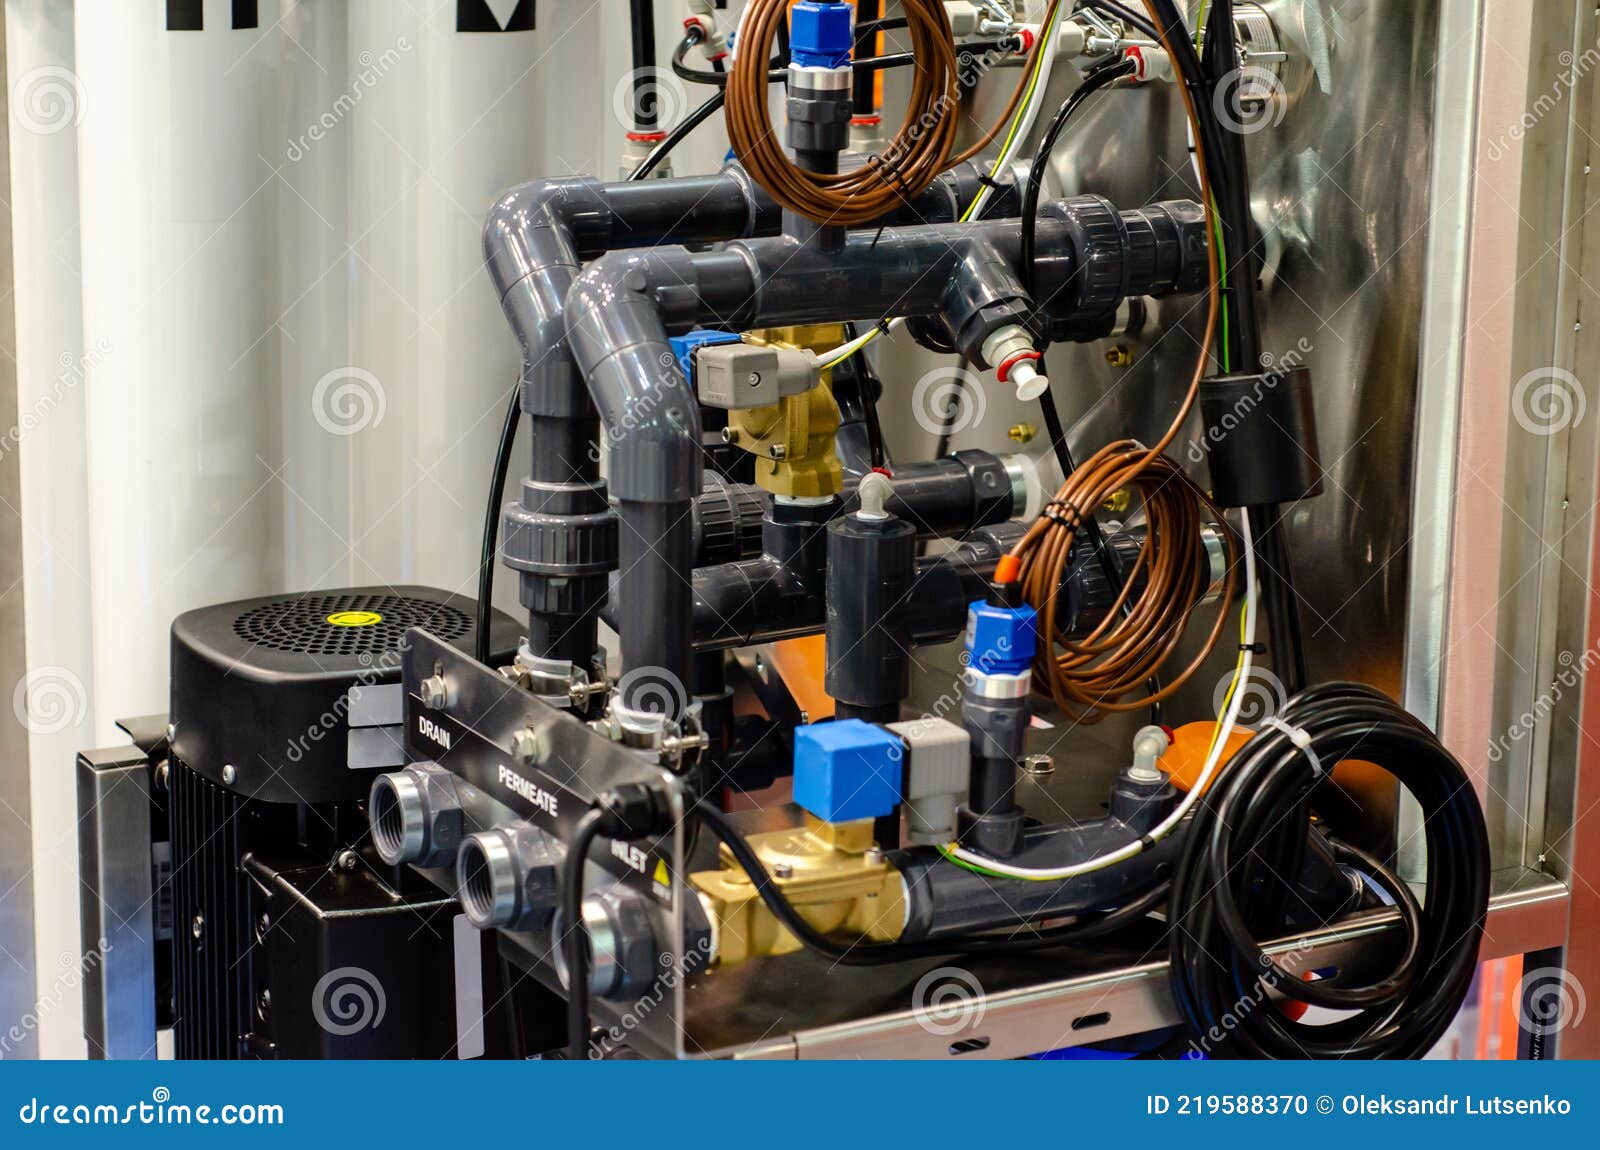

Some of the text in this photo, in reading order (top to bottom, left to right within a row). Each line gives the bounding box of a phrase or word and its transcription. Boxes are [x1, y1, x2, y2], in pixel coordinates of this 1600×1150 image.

[418, 715, 451, 750] DRAIN
[498, 764, 559, 818] PERMEATE
[611, 838, 648, 874] INLET
